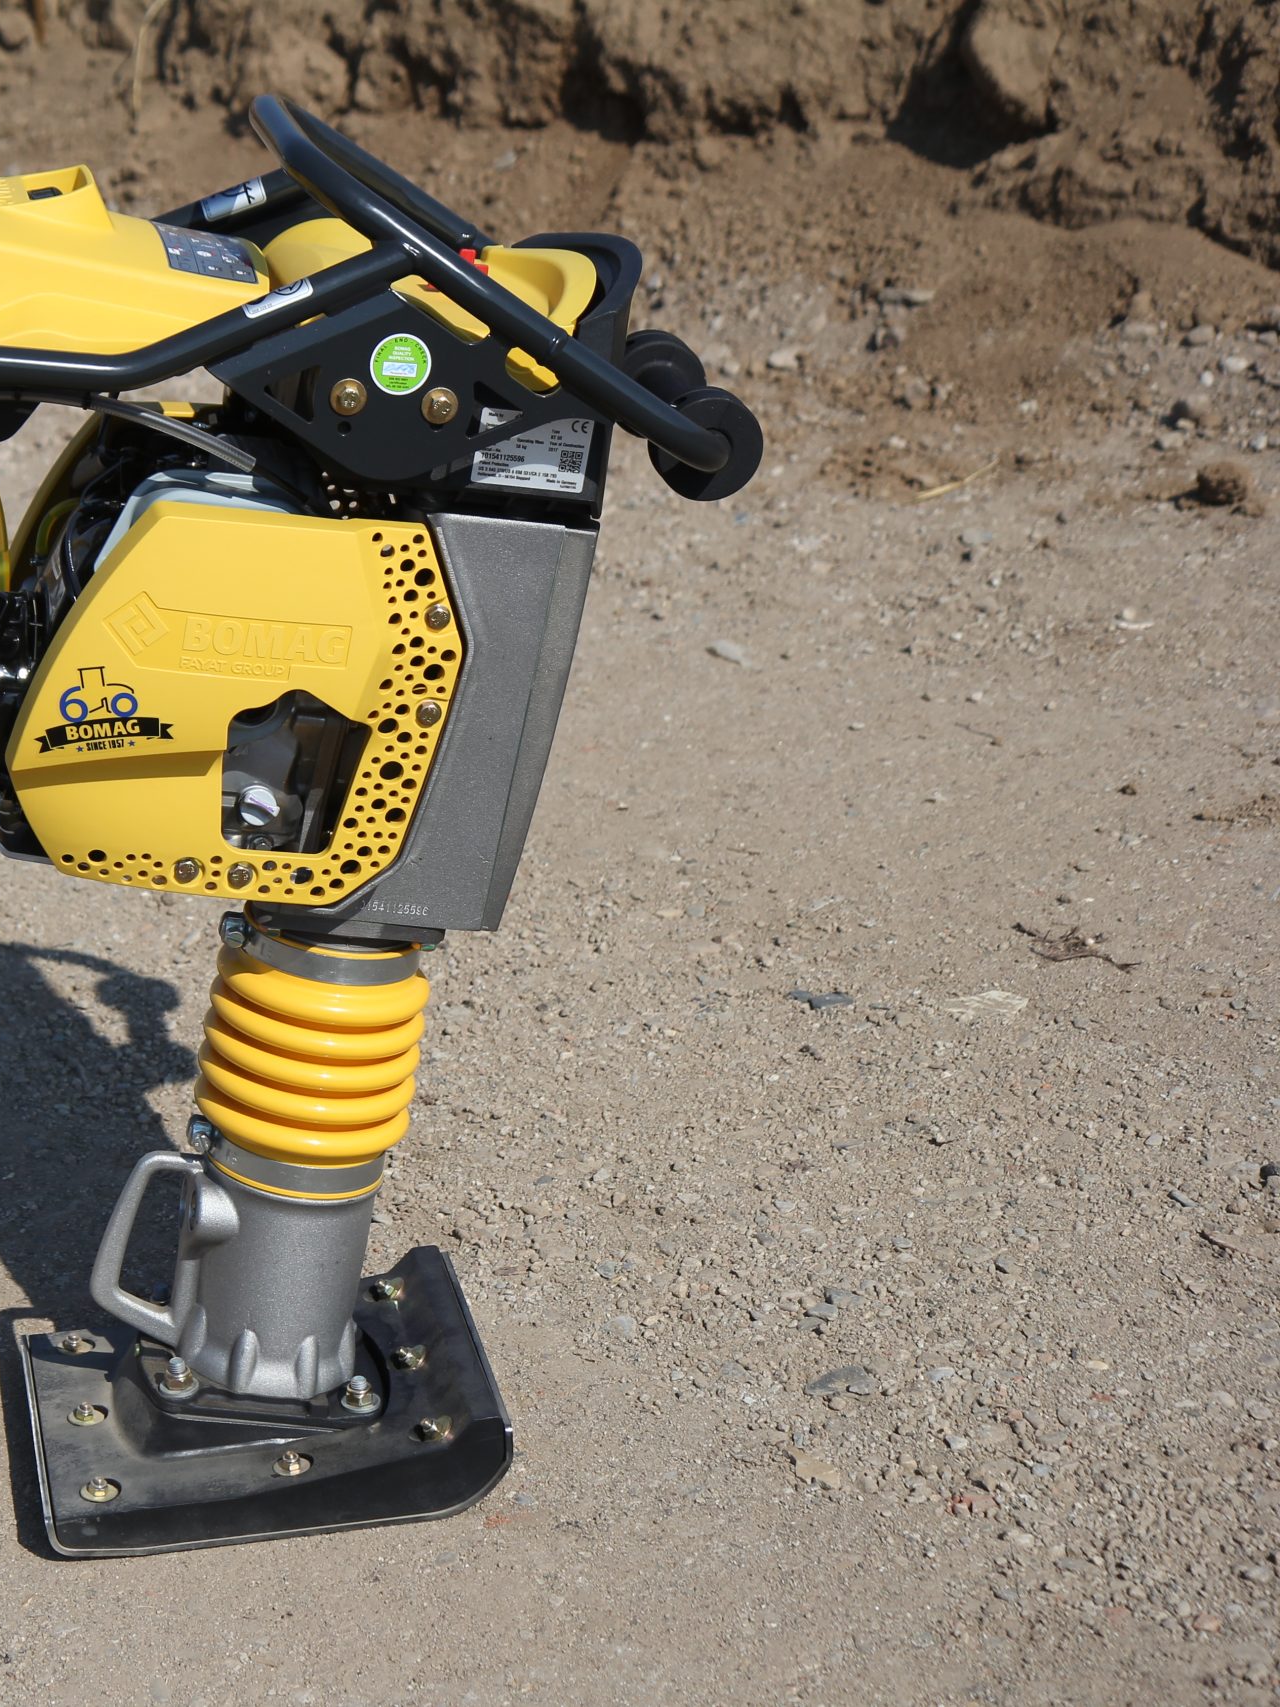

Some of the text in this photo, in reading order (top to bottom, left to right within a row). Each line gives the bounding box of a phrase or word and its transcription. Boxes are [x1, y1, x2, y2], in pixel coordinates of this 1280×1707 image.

[375, 346, 387, 362] FINAL
[415, 344, 426, 363] CHECK
[572, 420, 589, 434] CE
[481, 452, 525, 462] 701541125596
[182, 616, 347, 664] BOMAG
[180, 656, 285, 677] FAYAT GROUP
[65, 719, 140, 741] BOMAG
[86, 739, 124, 751] SINCE 1957
